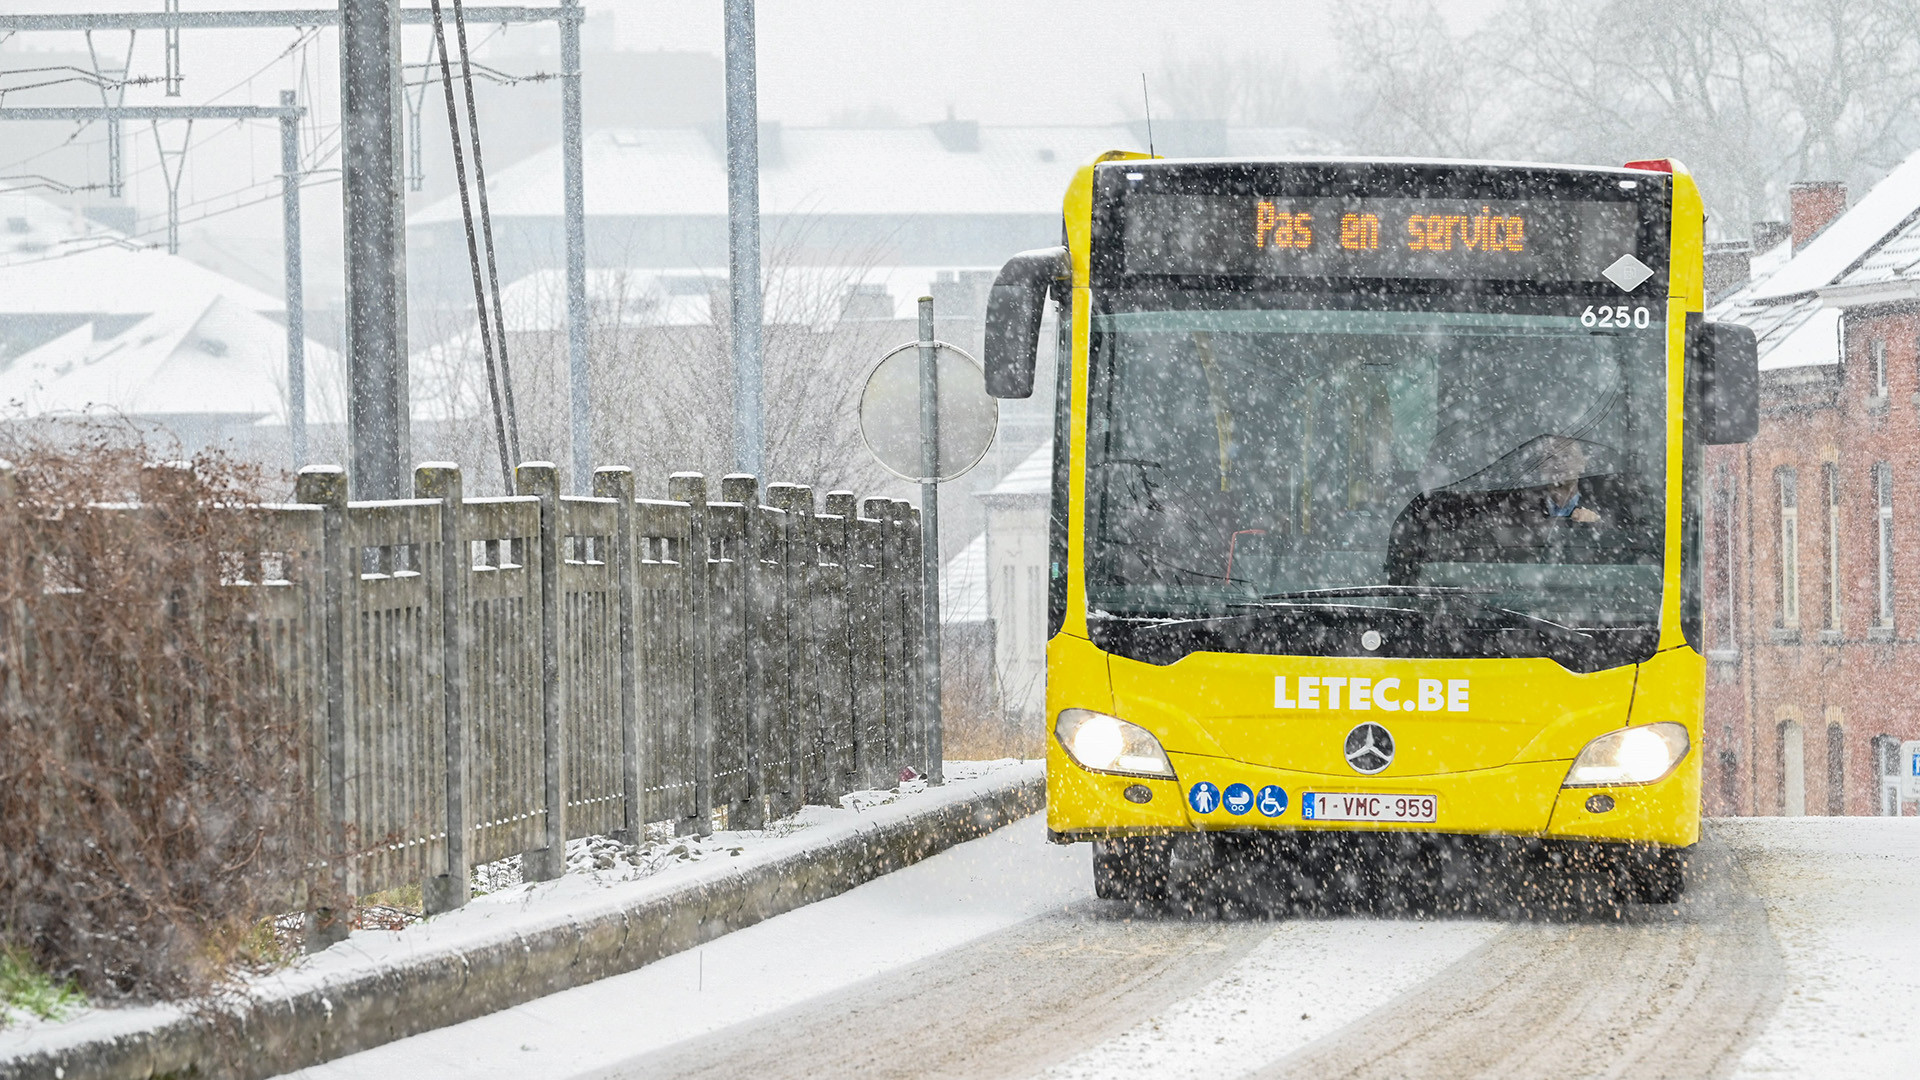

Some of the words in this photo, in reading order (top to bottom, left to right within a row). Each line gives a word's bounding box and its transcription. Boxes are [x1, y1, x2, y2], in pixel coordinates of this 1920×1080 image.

[1257, 201, 1312, 249] Pas
[1341, 213, 1379, 250] en
[1408, 206, 1524, 252] service
[1580, 305, 1650, 330] 6250
[1274, 676, 1470, 712] LETEC.BE
[1305, 808, 1313, 817] B
[1318, 796, 1433, 818] 1-VMC-959
